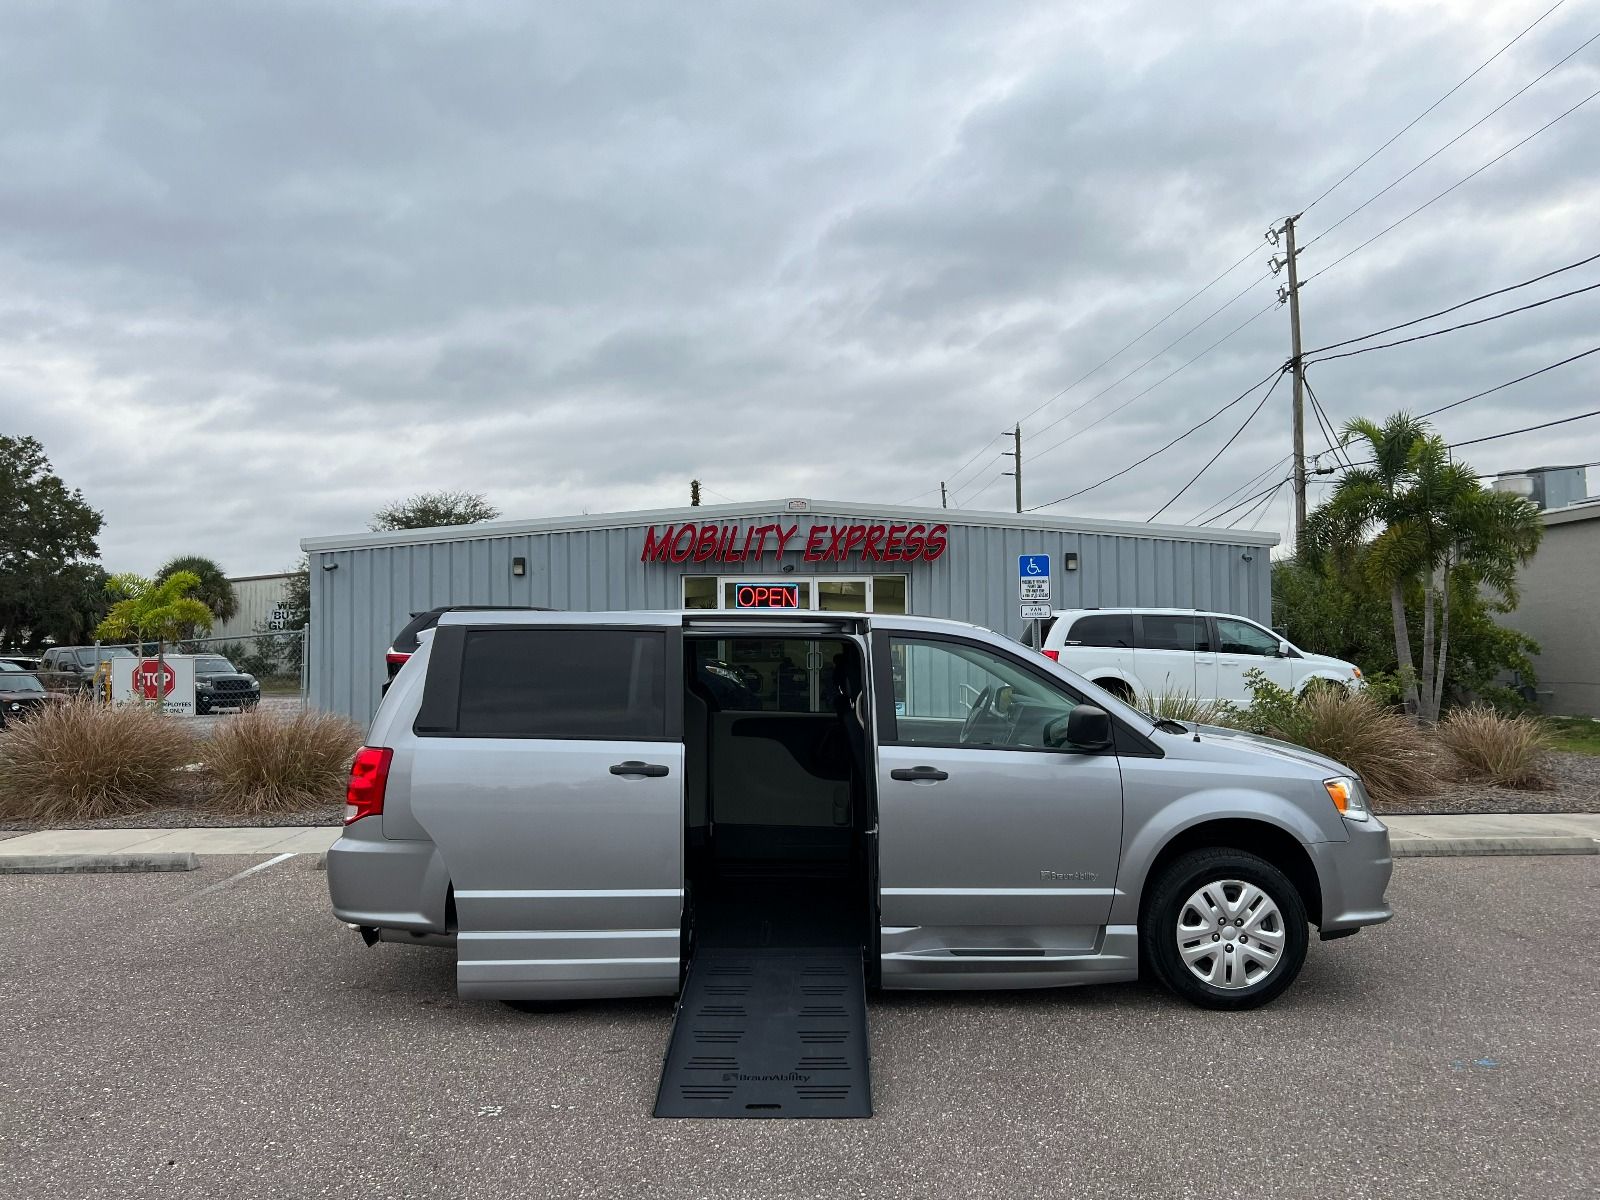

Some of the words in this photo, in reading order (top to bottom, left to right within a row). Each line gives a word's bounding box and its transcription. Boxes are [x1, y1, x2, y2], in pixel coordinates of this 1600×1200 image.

[640, 523, 798, 563] MOBILITY
[803, 524, 949, 563] EXPRESS
[738, 587, 797, 607] OPEN
[137, 672, 171, 686] STOP
[739, 1072, 811, 1083] BraunAbility
